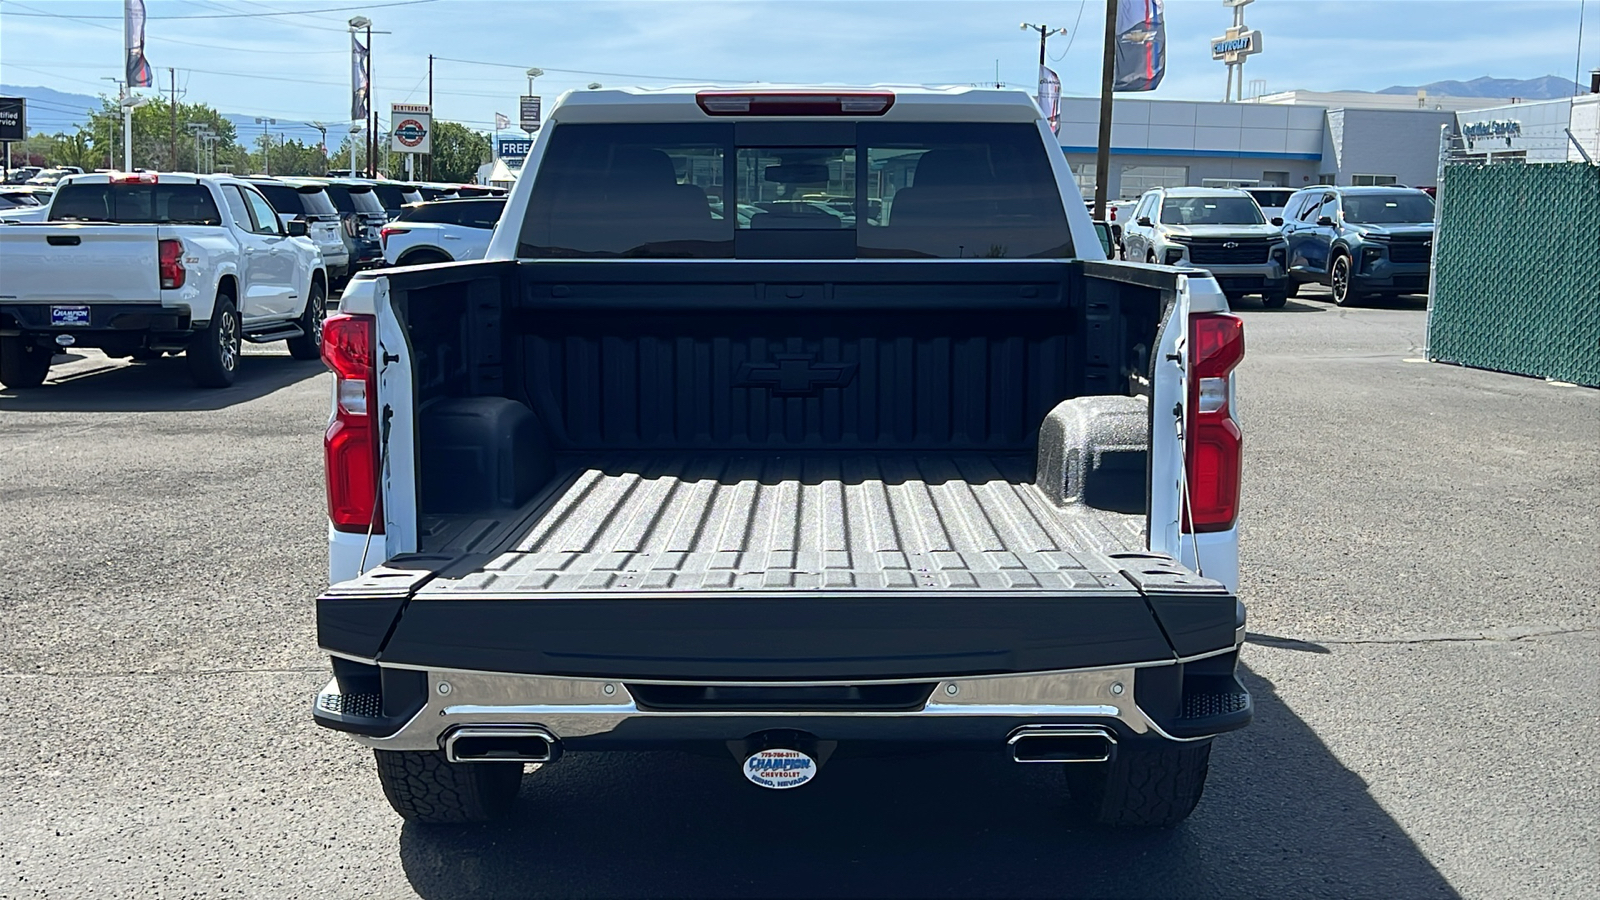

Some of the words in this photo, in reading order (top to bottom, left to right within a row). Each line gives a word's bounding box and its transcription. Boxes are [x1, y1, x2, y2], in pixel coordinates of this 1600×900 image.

[502, 143, 530, 154] FREE
[53, 309, 87, 317] CHAMPION
[749, 757, 811, 771] CHAMPION
[777, 775, 809, 787] NEVADA
